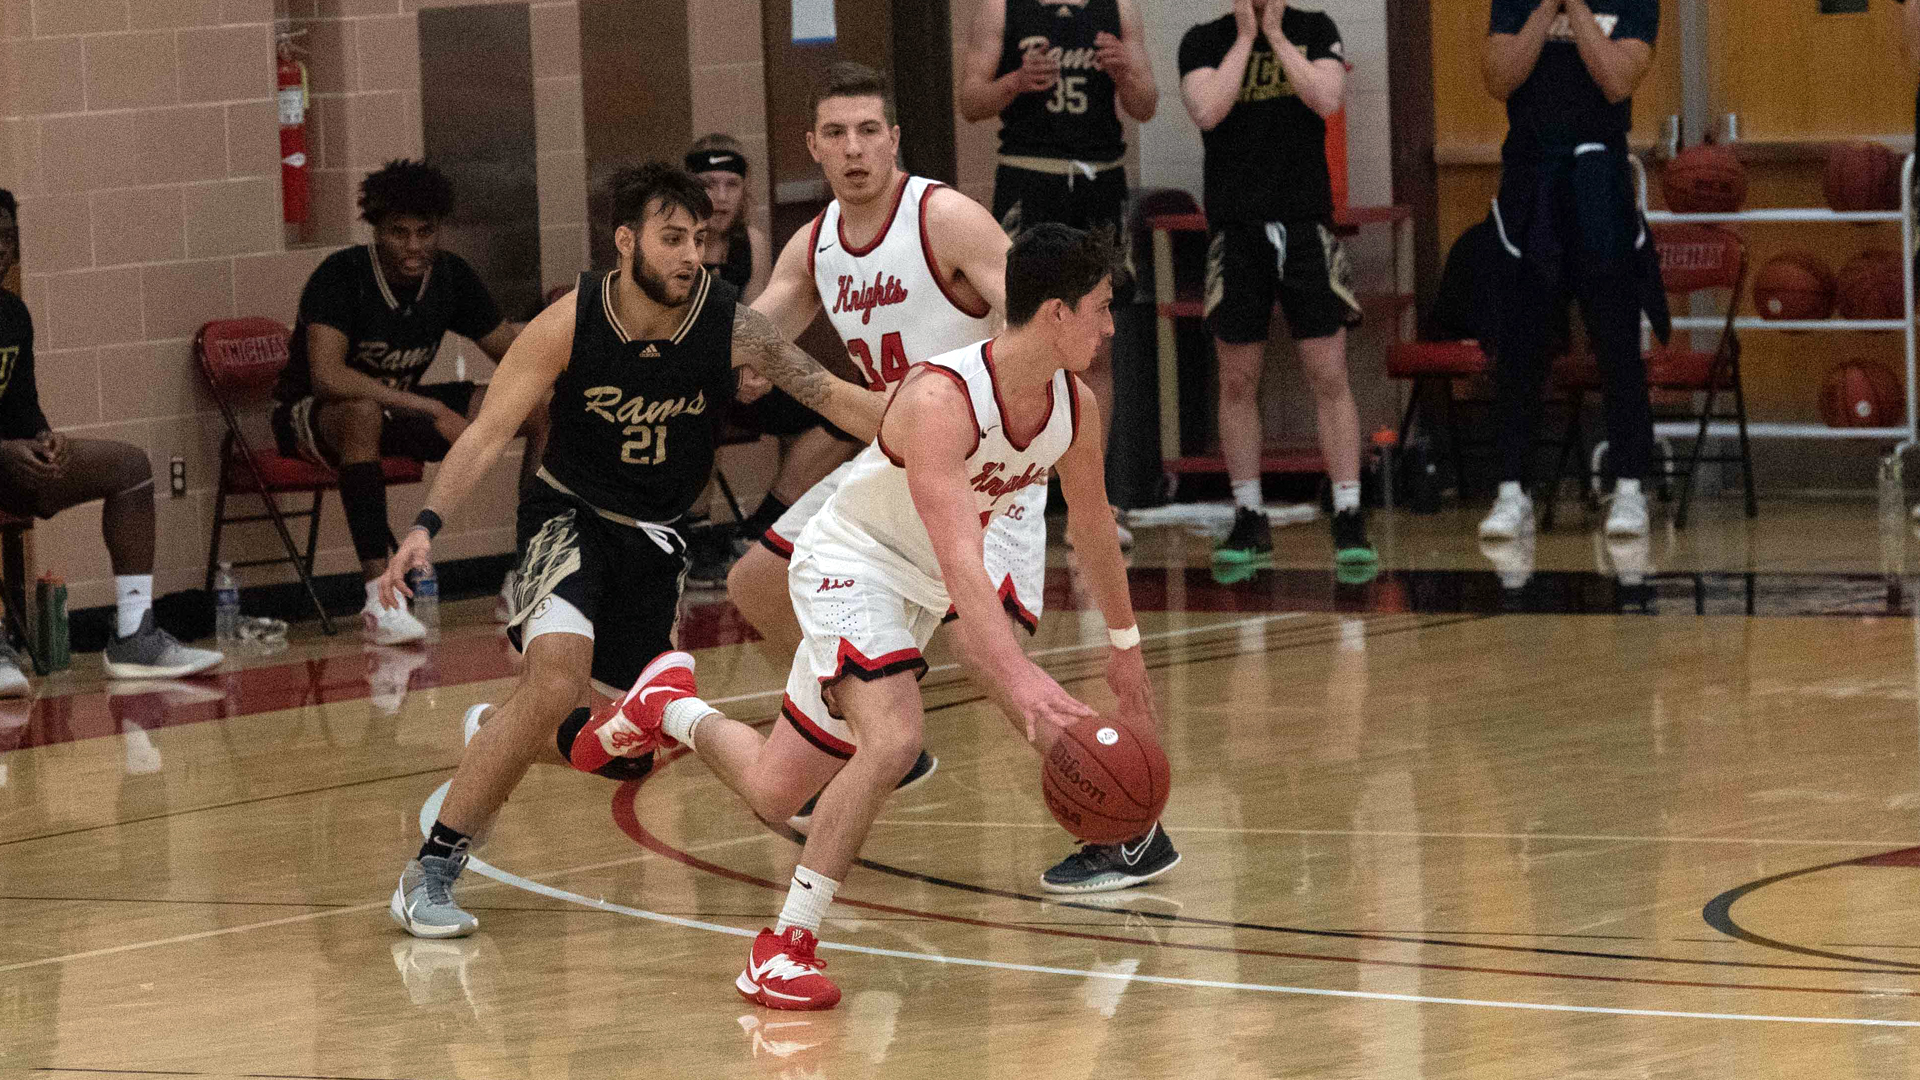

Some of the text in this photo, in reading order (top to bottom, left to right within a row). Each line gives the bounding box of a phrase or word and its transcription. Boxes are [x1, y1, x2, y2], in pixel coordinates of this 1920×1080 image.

[1045, 76, 1088, 114] 35
[832, 271, 909, 326] Knights
[846, 331, 912, 393] 34
[583, 385, 707, 425] Rams
[620, 424, 668, 466] 21
